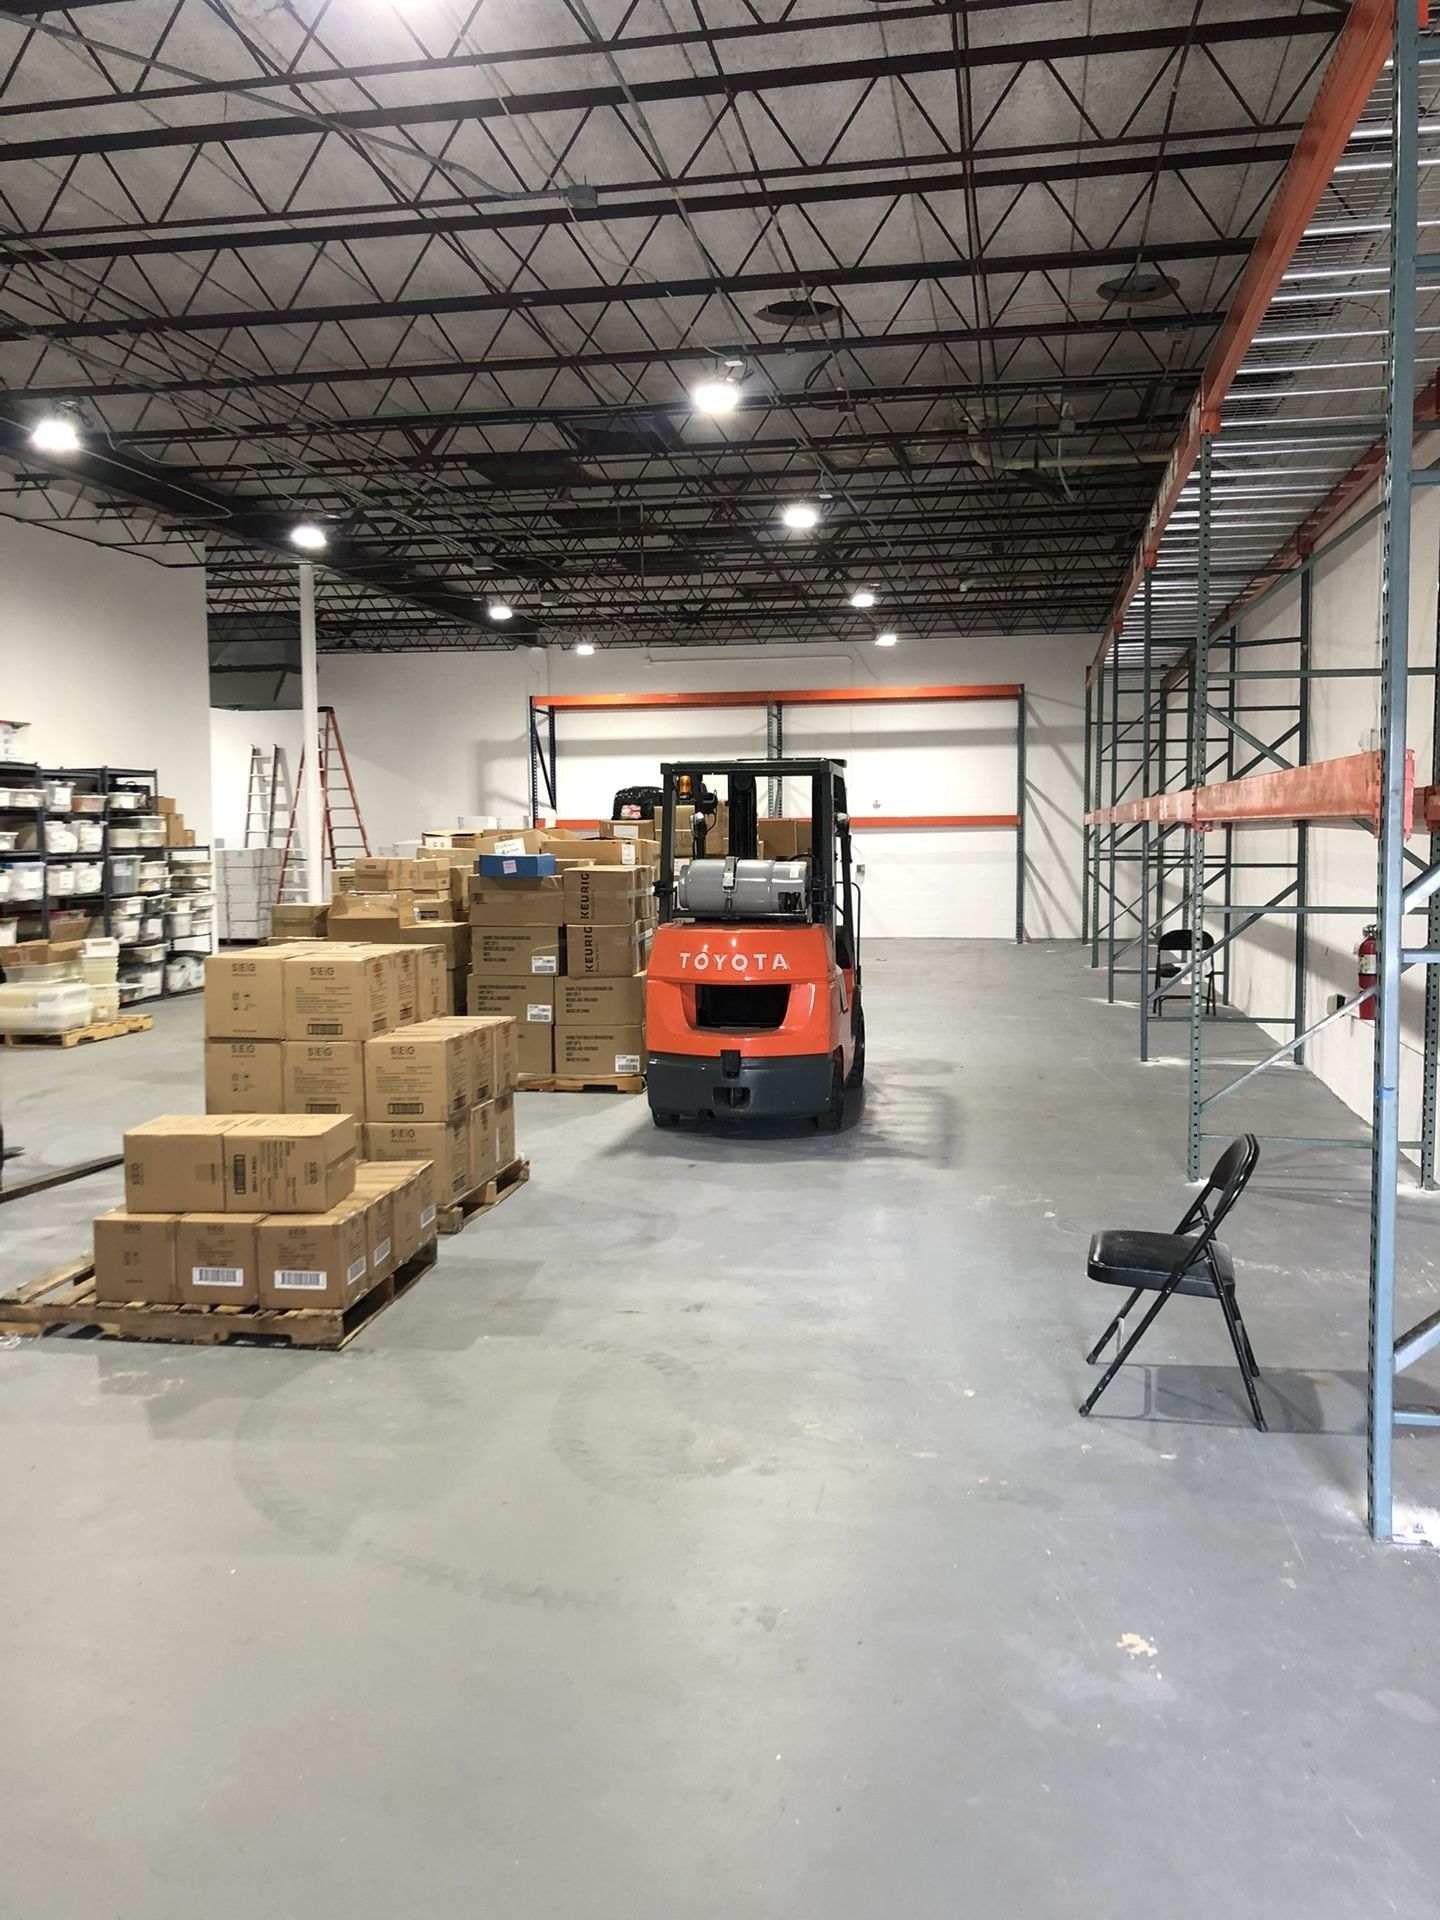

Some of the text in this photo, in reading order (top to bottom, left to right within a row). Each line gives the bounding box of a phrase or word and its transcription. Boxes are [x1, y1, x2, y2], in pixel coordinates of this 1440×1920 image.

[580, 873, 590, 919] KEURIG
[584, 926, 594, 972] KEURIG
[231, 963, 256, 972] SEG
[679, 952, 789, 971] TOYOTA
[309, 967, 335, 976] SEG
